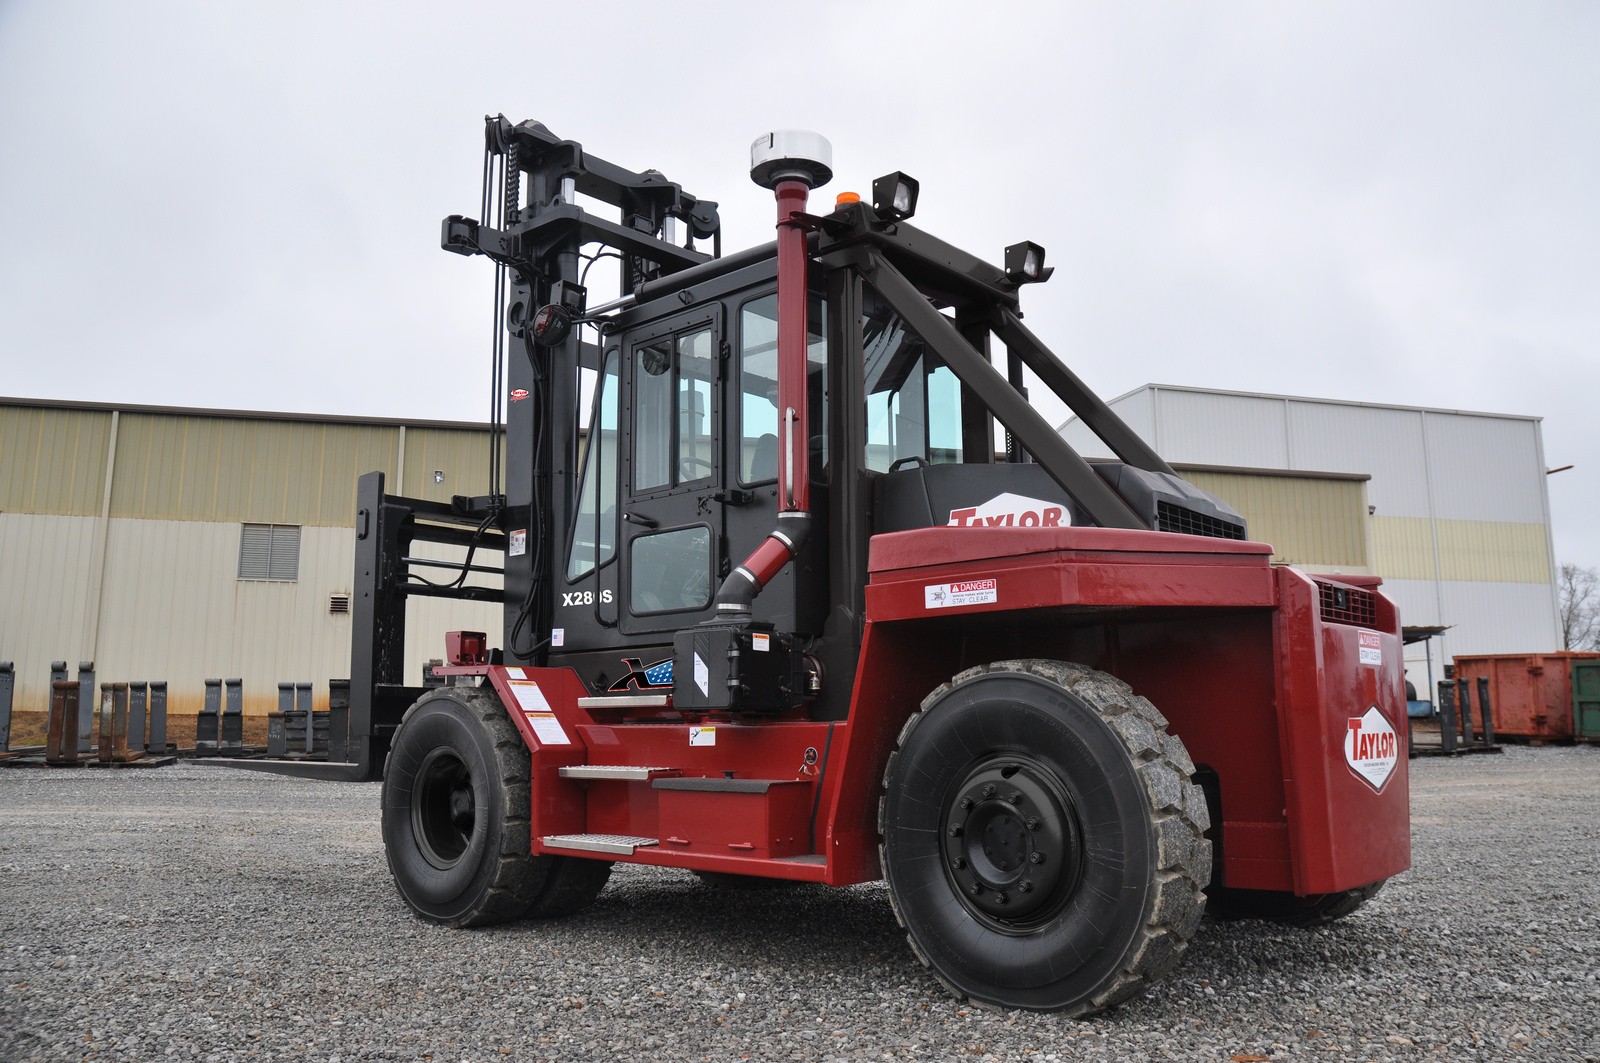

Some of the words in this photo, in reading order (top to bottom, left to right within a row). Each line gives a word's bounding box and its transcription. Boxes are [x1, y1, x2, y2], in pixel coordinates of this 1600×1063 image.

[960, 581, 993, 592] DANGER
[969, 595, 989, 603] CLEAR
[1363, 634, 1380, 647] DANGER
[1349, 719, 1395, 761] TAYLOR
